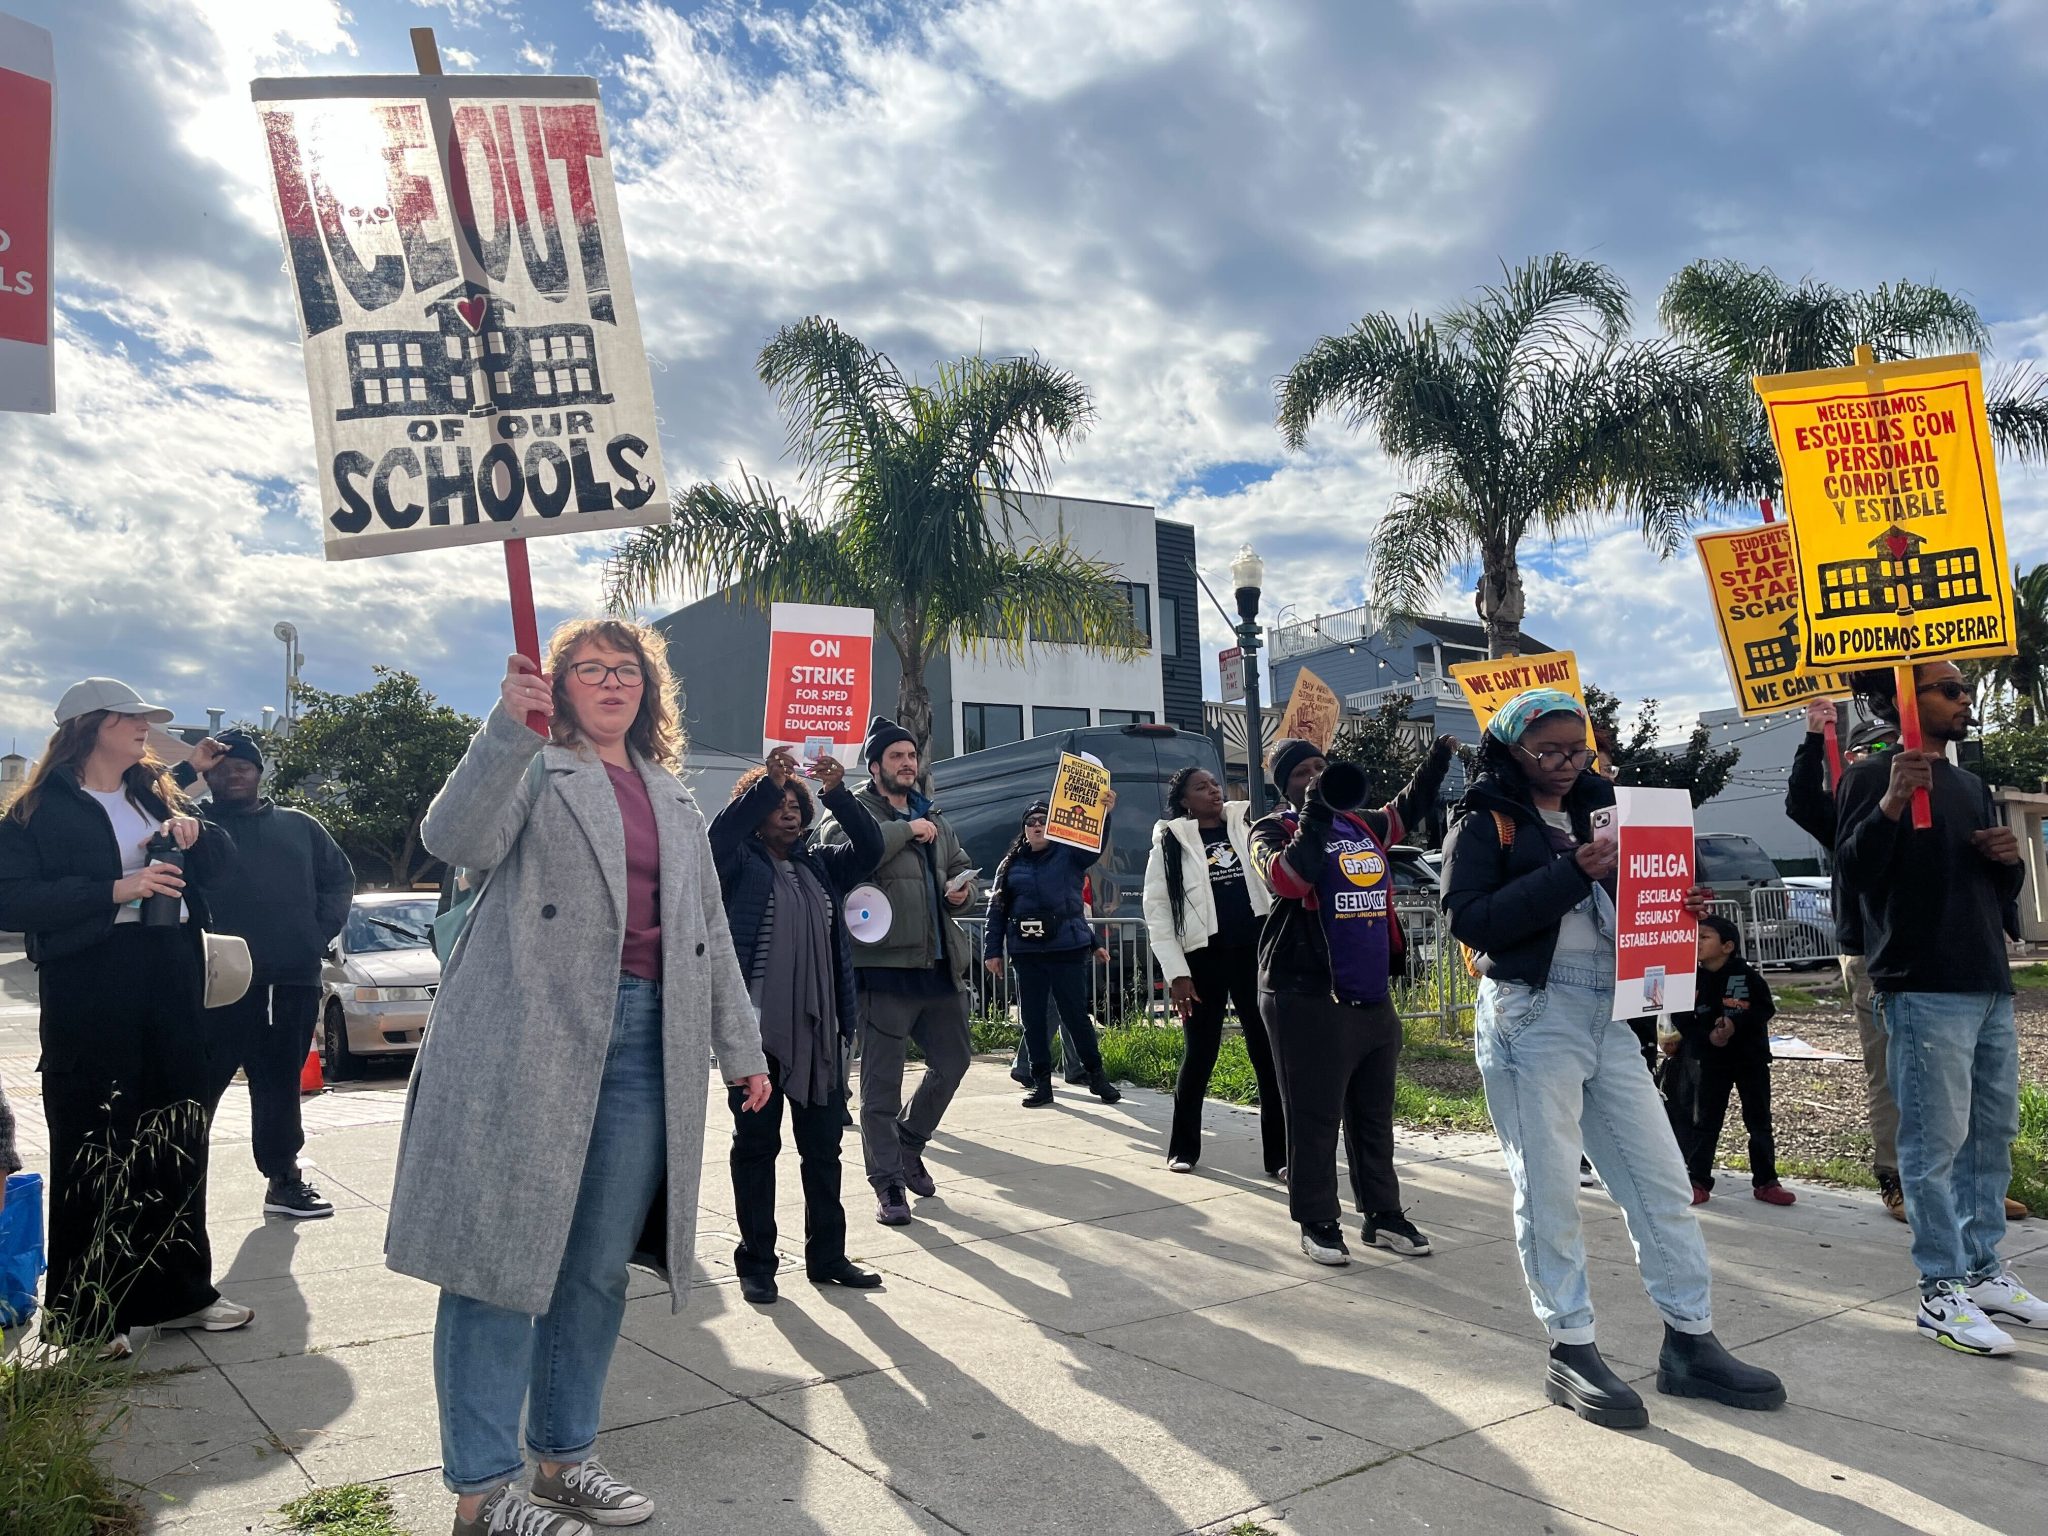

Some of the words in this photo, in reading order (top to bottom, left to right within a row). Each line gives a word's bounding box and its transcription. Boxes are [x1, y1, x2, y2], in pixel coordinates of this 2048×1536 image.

[448, 104, 617, 327] OUT
[1817, 395, 1927, 422] NECESITAMOS
[407, 418, 464, 442] OF
[497, 410, 595, 439] OUR
[1795, 417, 1905, 451] ESCUELAS
[1913, 410, 1956, 437] CON
[1826, 439, 1938, 473] PERSONAL
[330, 433, 656, 533] SCHOOLS
[1823, 465, 1940, 500] COMPLETO
[1832, 500, 1847, 525] Y
[1856, 490, 1947, 523] ESTABLE
[1730, 529, 1791, 553] STUDENTS
[1735, 541, 1793, 568] FUL
[1814, 631, 1836, 657] NO
[1839, 624, 1921, 654] PODEMOS
[1926, 615, 1999, 647] ESPERAR
[809, 639, 841, 658] ON
[790, 665, 856, 686] STRIKE
[1465, 675, 1495, 695] WE
[1492, 666, 1532, 690] CAN'T
[1534, 660, 1570, 685] WAIT
[796, 688, 819, 700] FOR
[822, 689, 848, 701] SPED
[1751, 682, 1780, 704] WE
[787, 703, 843, 716] STUDENTS
[844, 705, 854, 717] &
[784, 718, 851, 732] EDUCATORS
[1062, 764, 1094, 780] ESCUELAS
[1096, 775, 1107, 786] CON
[1068, 774, 1100, 791] PERSONAL
[1063, 782, 1099, 799] COMPLETO
[1064, 790, 1069, 799] Y
[1069, 792, 1097, 808] ESTABLE
[1342, 856, 1382, 874] SFUSD
[1629, 853, 1688, 879] HUELGA
[1336, 892, 1370, 911] SEIU
[1637, 888, 1682, 908] ¡ESCUELAS
[1634, 909, 1674, 926] SEGURAS
[1673, 909, 1681, 923] Y
[1619, 932, 1659, 949] ESTABLES
[1660, 929, 1695, 945] AHORA!
